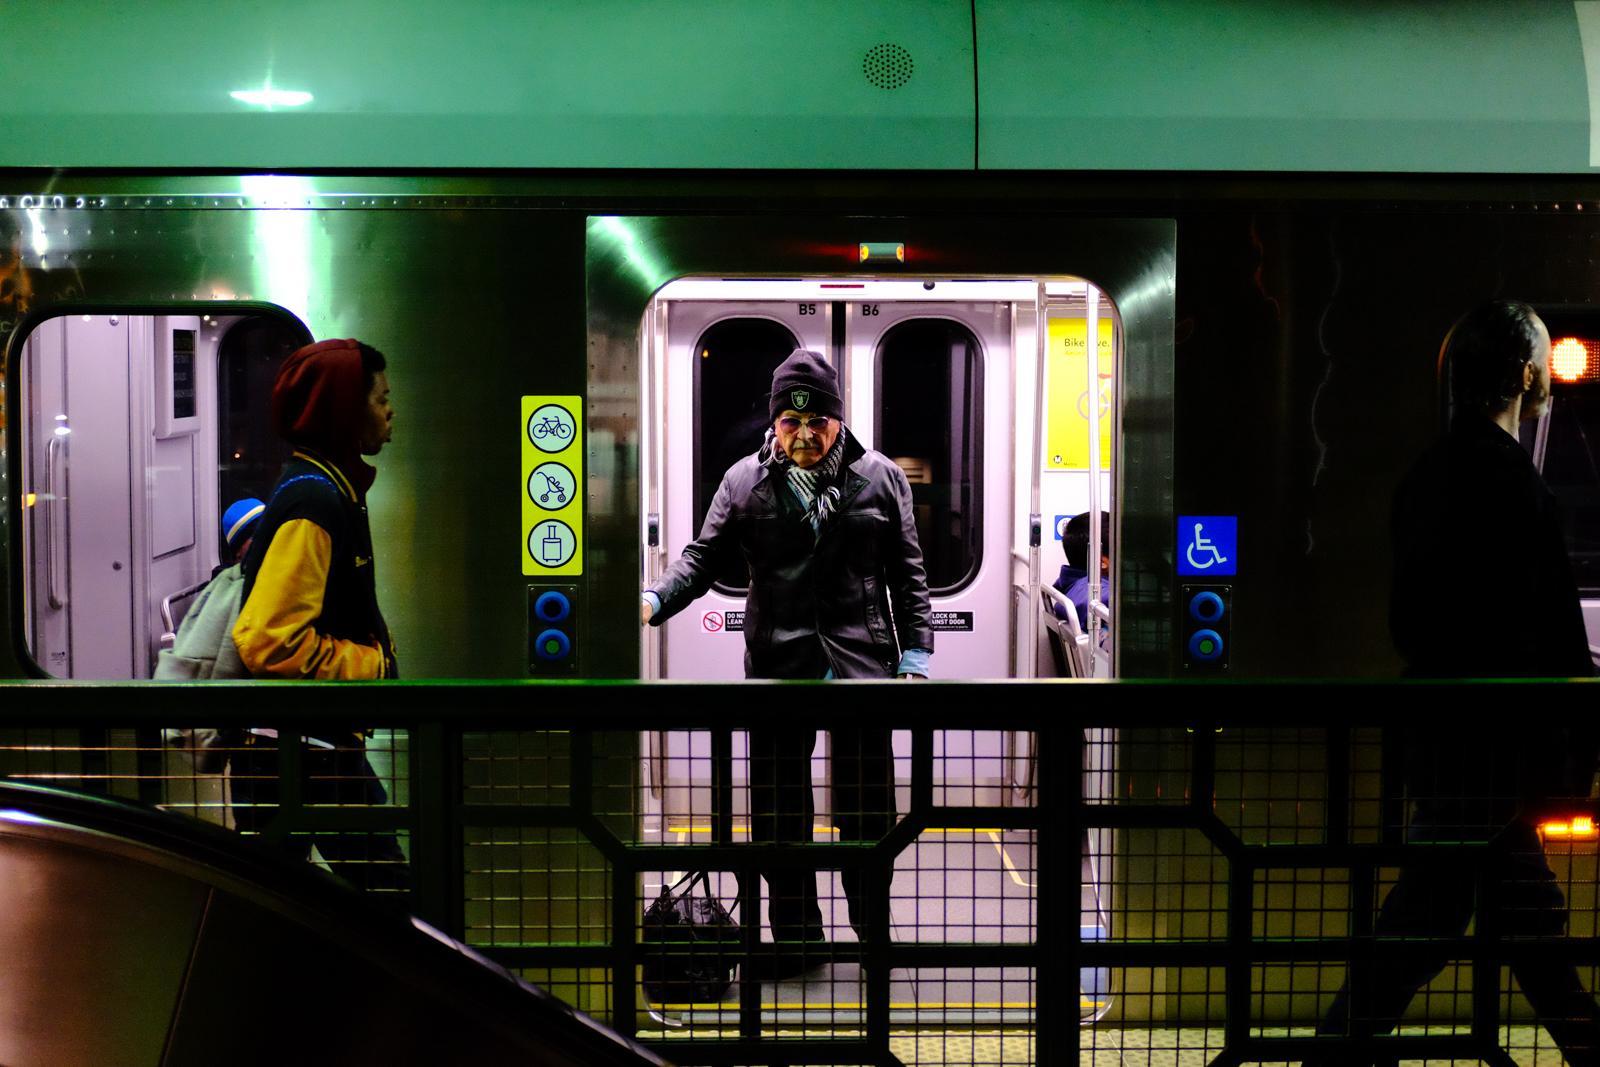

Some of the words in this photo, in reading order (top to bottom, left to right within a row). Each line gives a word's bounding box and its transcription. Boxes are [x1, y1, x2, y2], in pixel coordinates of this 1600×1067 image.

[799, 304, 816, 315] B5
[862, 304, 879, 316] B6
[1064, 338, 1085, 347] Bike
